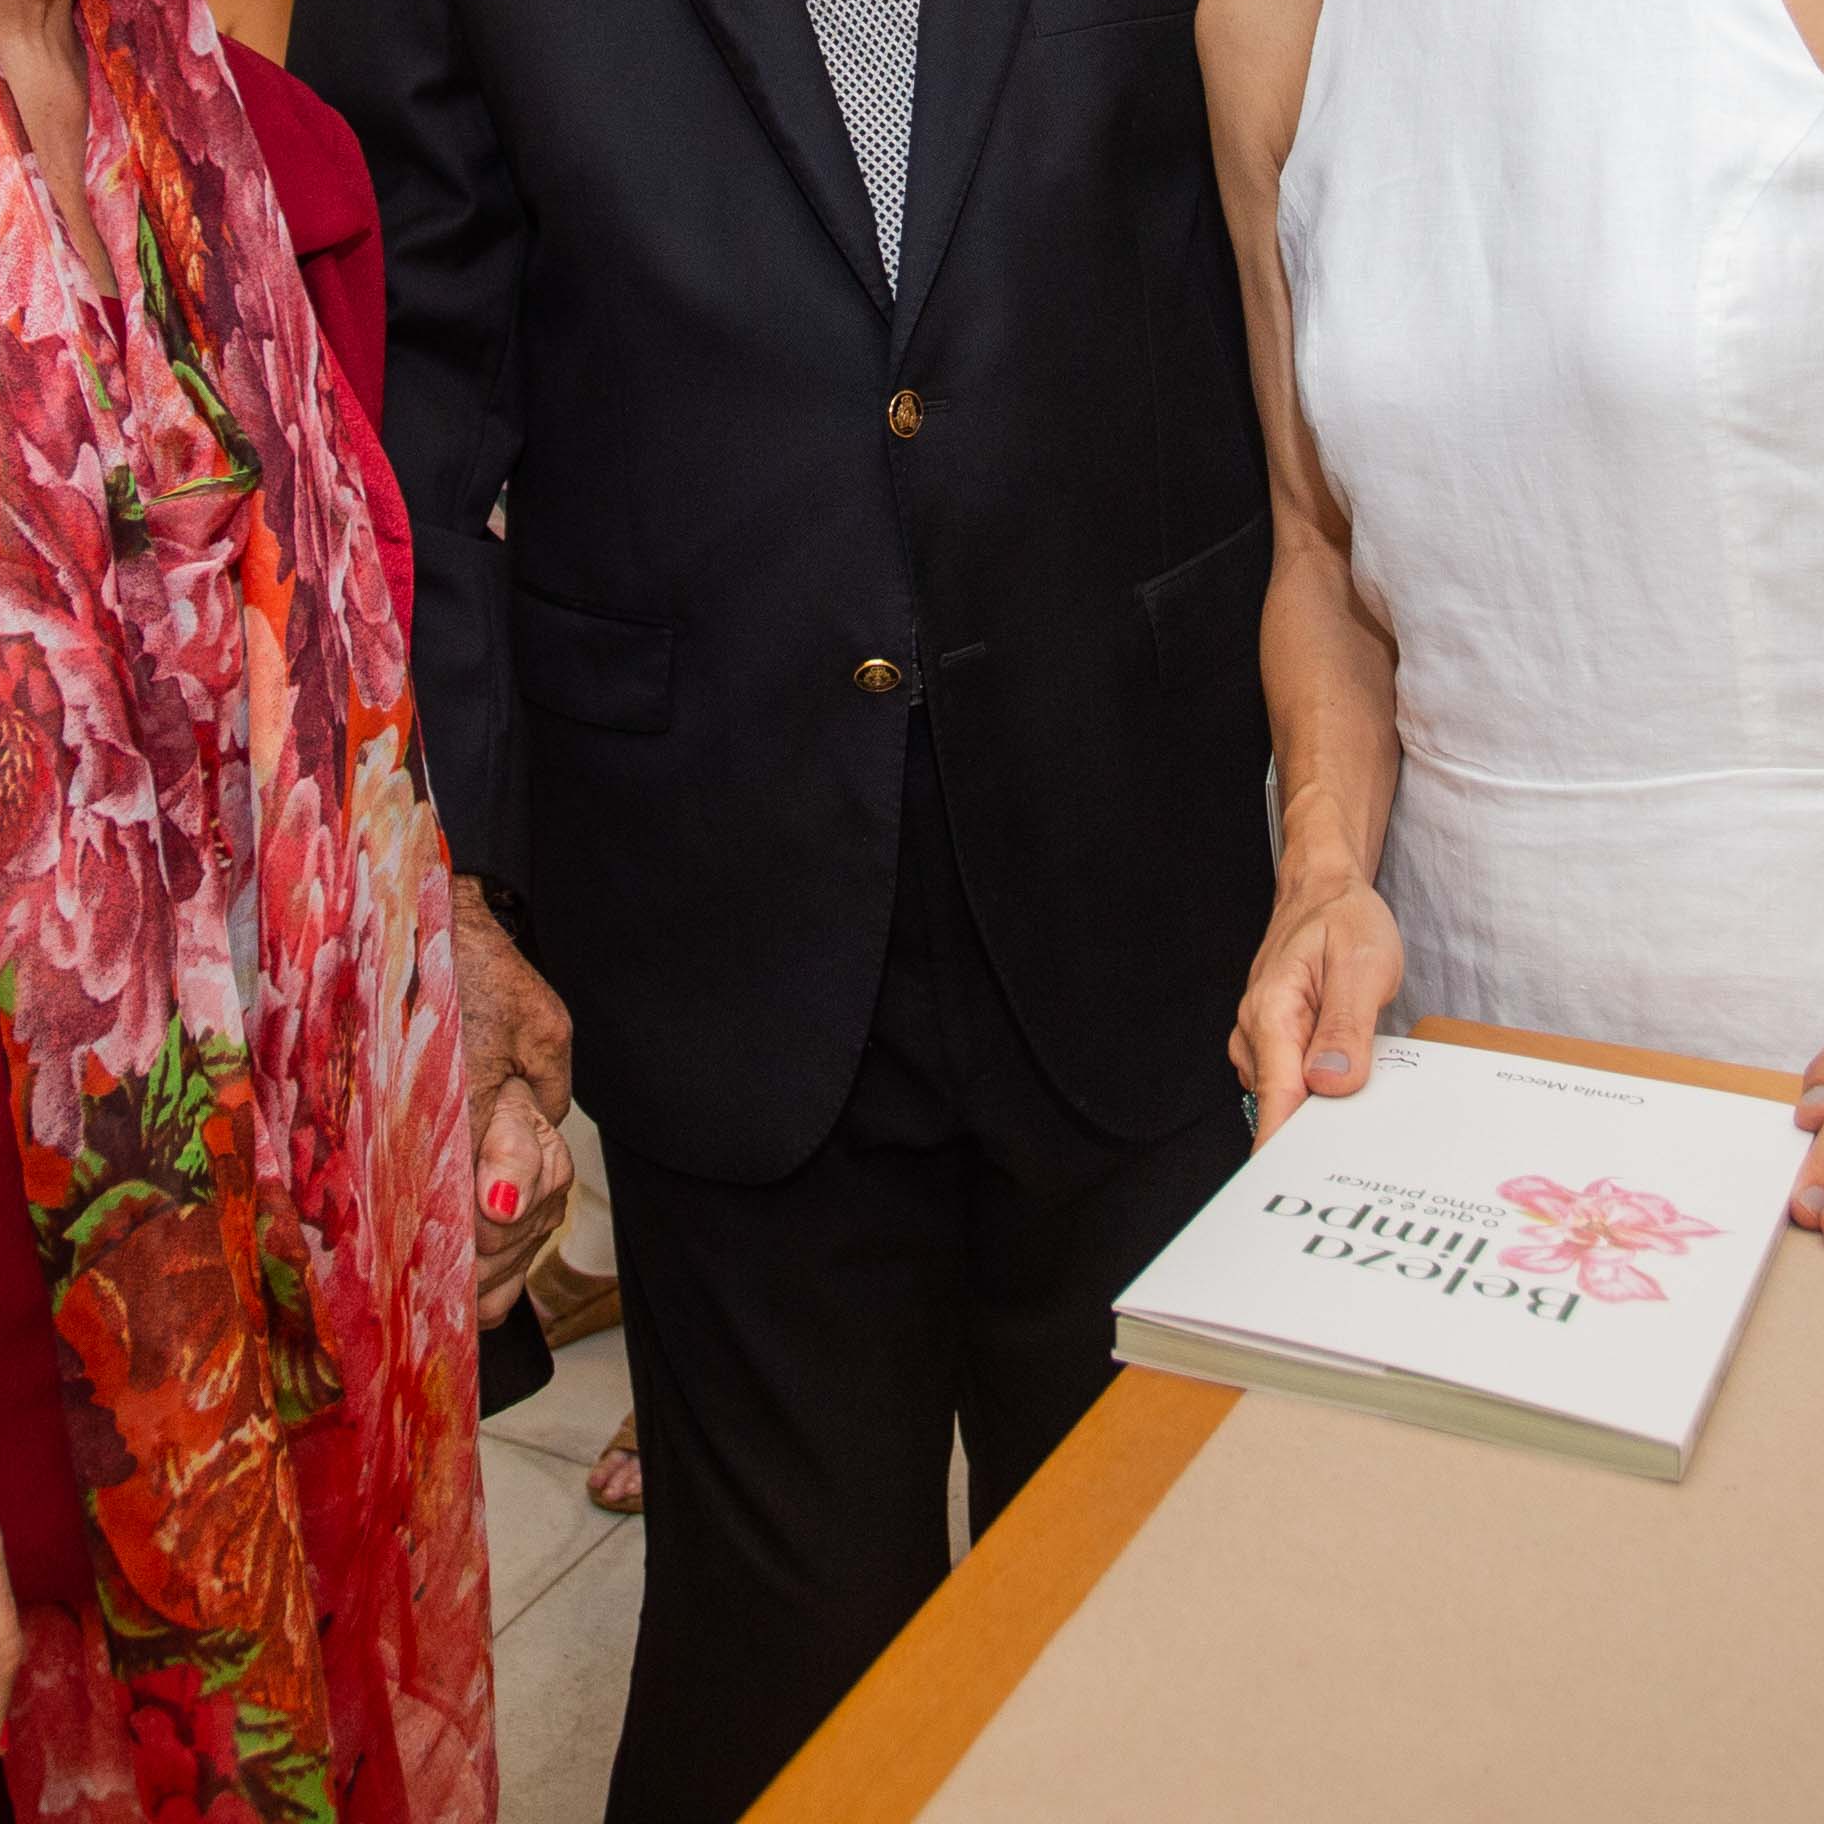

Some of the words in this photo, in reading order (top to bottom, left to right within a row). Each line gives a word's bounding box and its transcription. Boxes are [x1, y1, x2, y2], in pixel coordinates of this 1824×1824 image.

[1495, 1069, 1568, 1093] Meccia
[1573, 1083, 1646, 1106] Camila
[1324, 1172, 1427, 1200] praticar
[1377, 1196, 1393, 1205] e
[1431, 1192, 1507, 1218] como
[1422, 1204, 1475, 1224] que
[1481, 1219, 1499, 1228] o
[1262, 1193, 1489, 1265] limpa
[1301, 1234, 1582, 1324] Beleza
